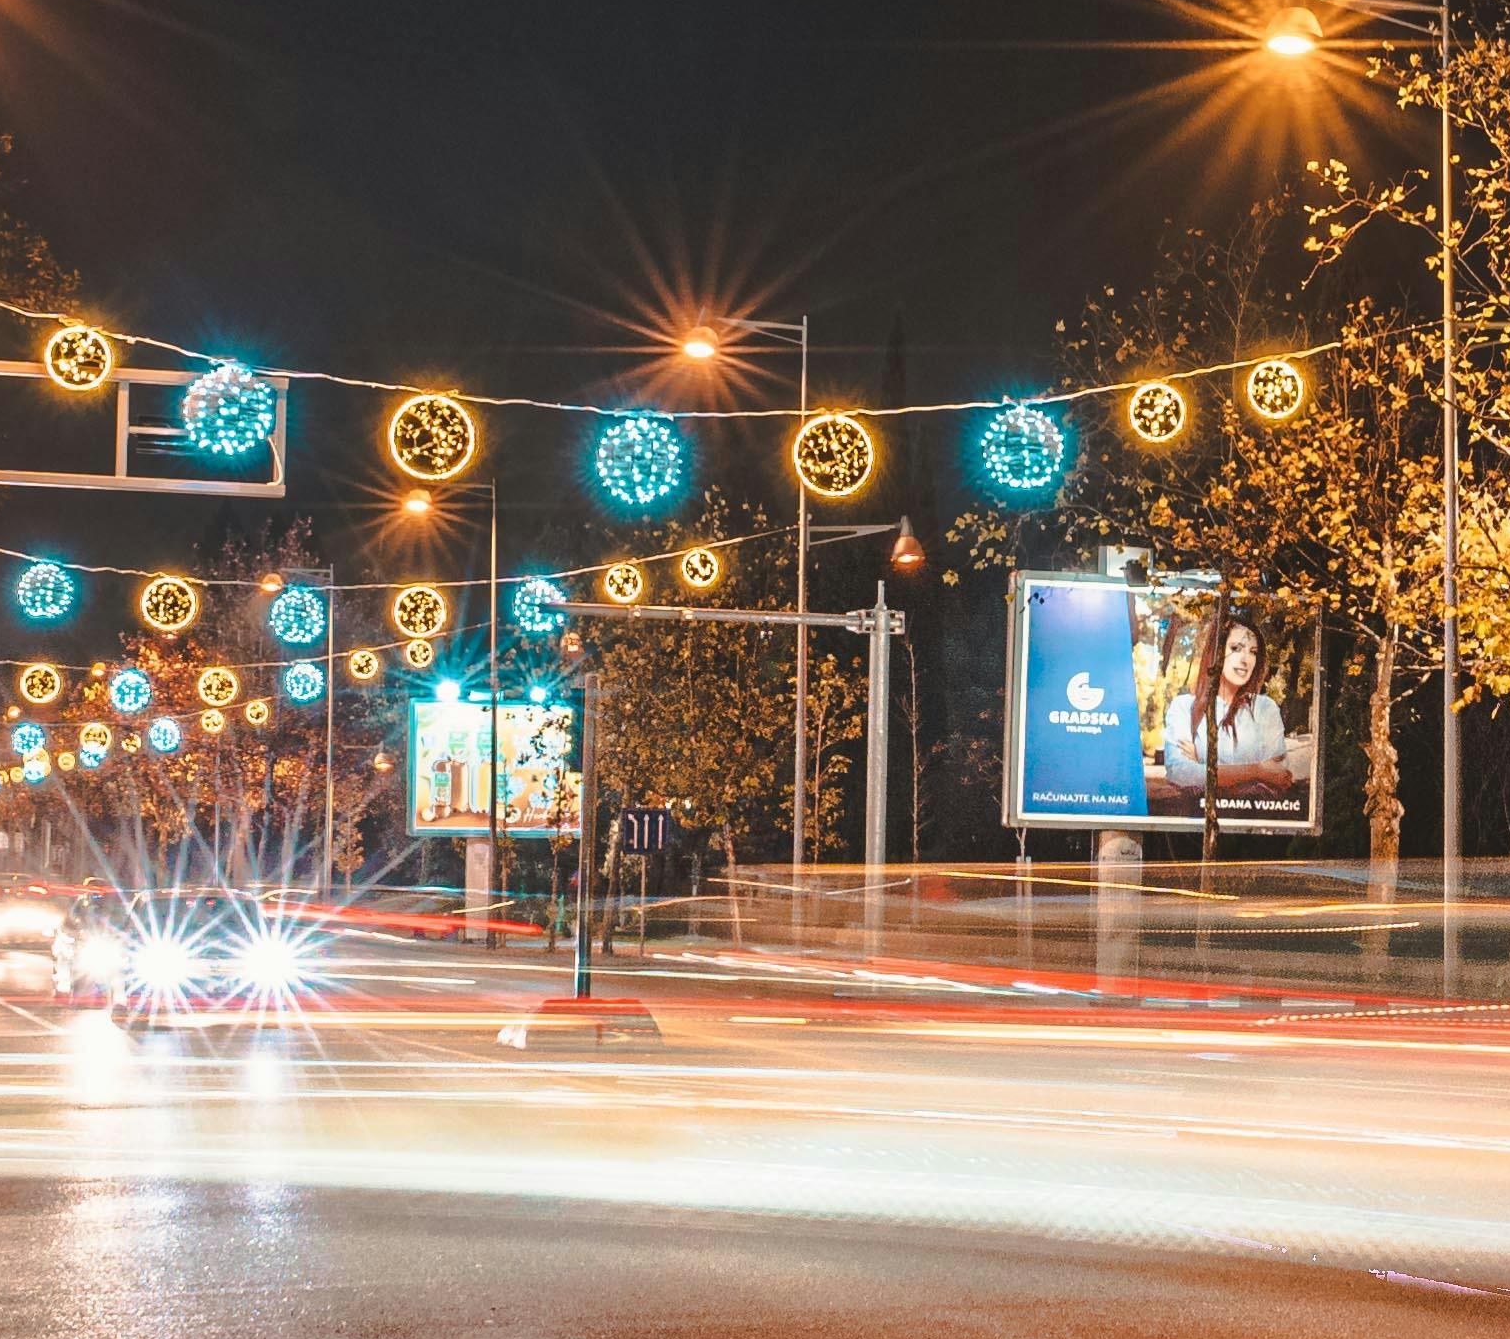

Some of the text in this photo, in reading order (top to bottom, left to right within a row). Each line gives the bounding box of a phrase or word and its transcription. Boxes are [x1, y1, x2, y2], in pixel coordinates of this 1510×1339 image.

[1049, 711, 1119, 725] GRADSKA
[1032, 792, 1129, 804] RAČUNAJTE NA NAS
